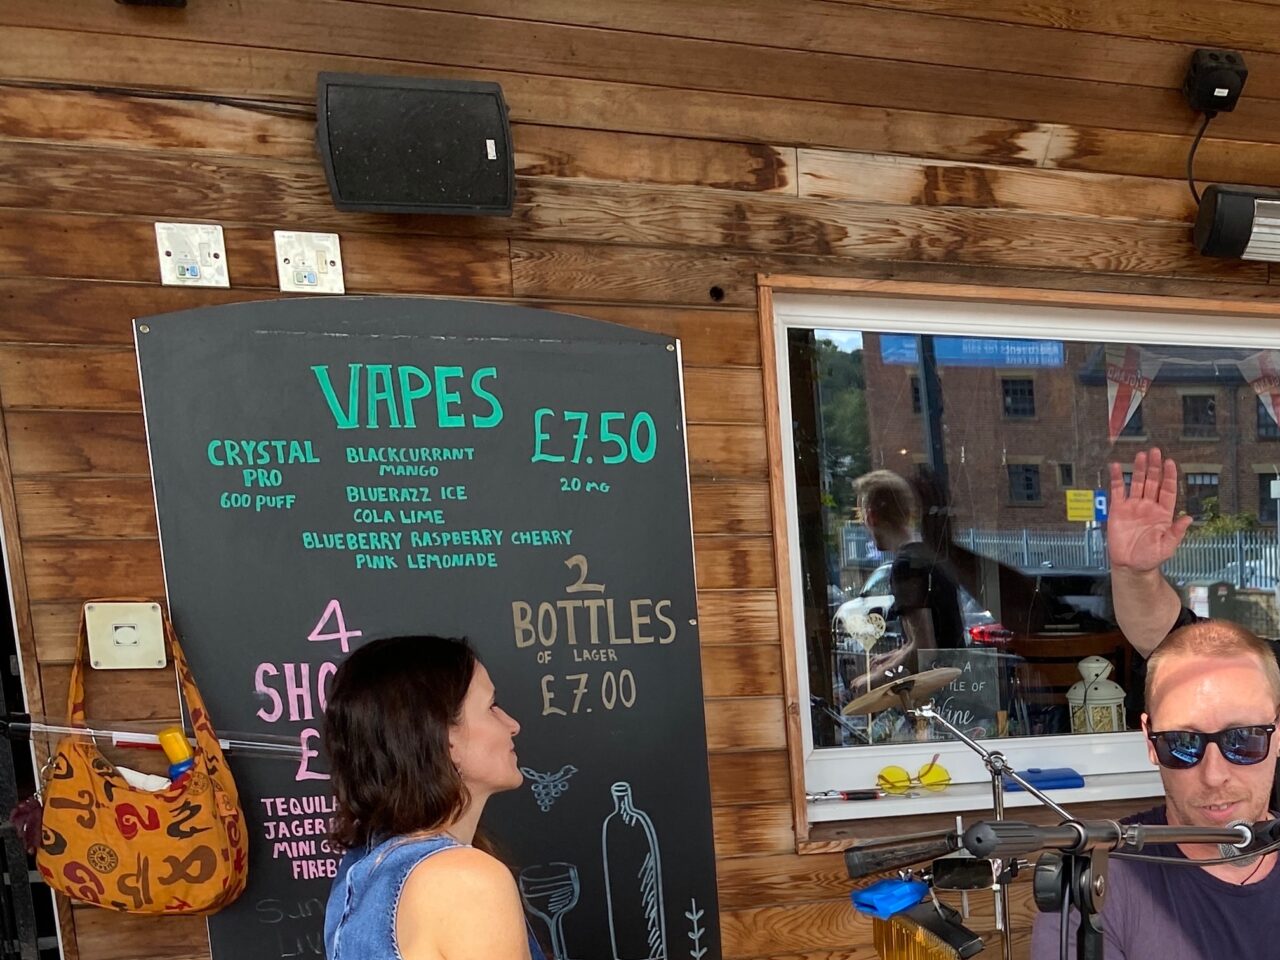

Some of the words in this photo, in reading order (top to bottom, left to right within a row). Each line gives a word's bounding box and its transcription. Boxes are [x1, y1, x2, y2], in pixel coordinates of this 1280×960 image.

[311, 363, 504, 429] VAPES
[531, 408, 657, 464] £7.50
[207, 440, 320, 466] CRYSTAL
[346, 447, 474, 463] BLACKCURRANT
[242, 469, 282, 487] PRO
[379, 465, 439, 476] MANGO
[346, 486, 431, 502] BLUERAZZ
[440, 486, 467, 500] ICE
[559, 478, 581, 492] 20
[220, 492, 250, 508] 600
[255, 494, 296, 511] PUFF
[353, 508, 395, 524] COLA
[400, 510, 445, 524] LIME
[302, 532, 402, 550] BLUEBERRY
[411, 529, 503, 547] RASPBERRY
[511, 530, 573, 545] CHERRY
[356, 554, 398, 569] PINK
[407, 553, 498, 569] LEMONADE
[564, 554, 606, 594] 2
[307, 599, 363, 653] 4
[511, 598, 677, 648] BOTTLES
[537, 651, 552, 664] OF
[573, 649, 618, 662] LAGER
[255, 662, 338, 722] SHO
[540, 669, 637, 715] £7.00
[971, 681, 986, 692] OF
[263, 819, 327, 840] JAGER
[272, 841, 316, 859] MINI
[292, 859, 343, 879] FIREB
